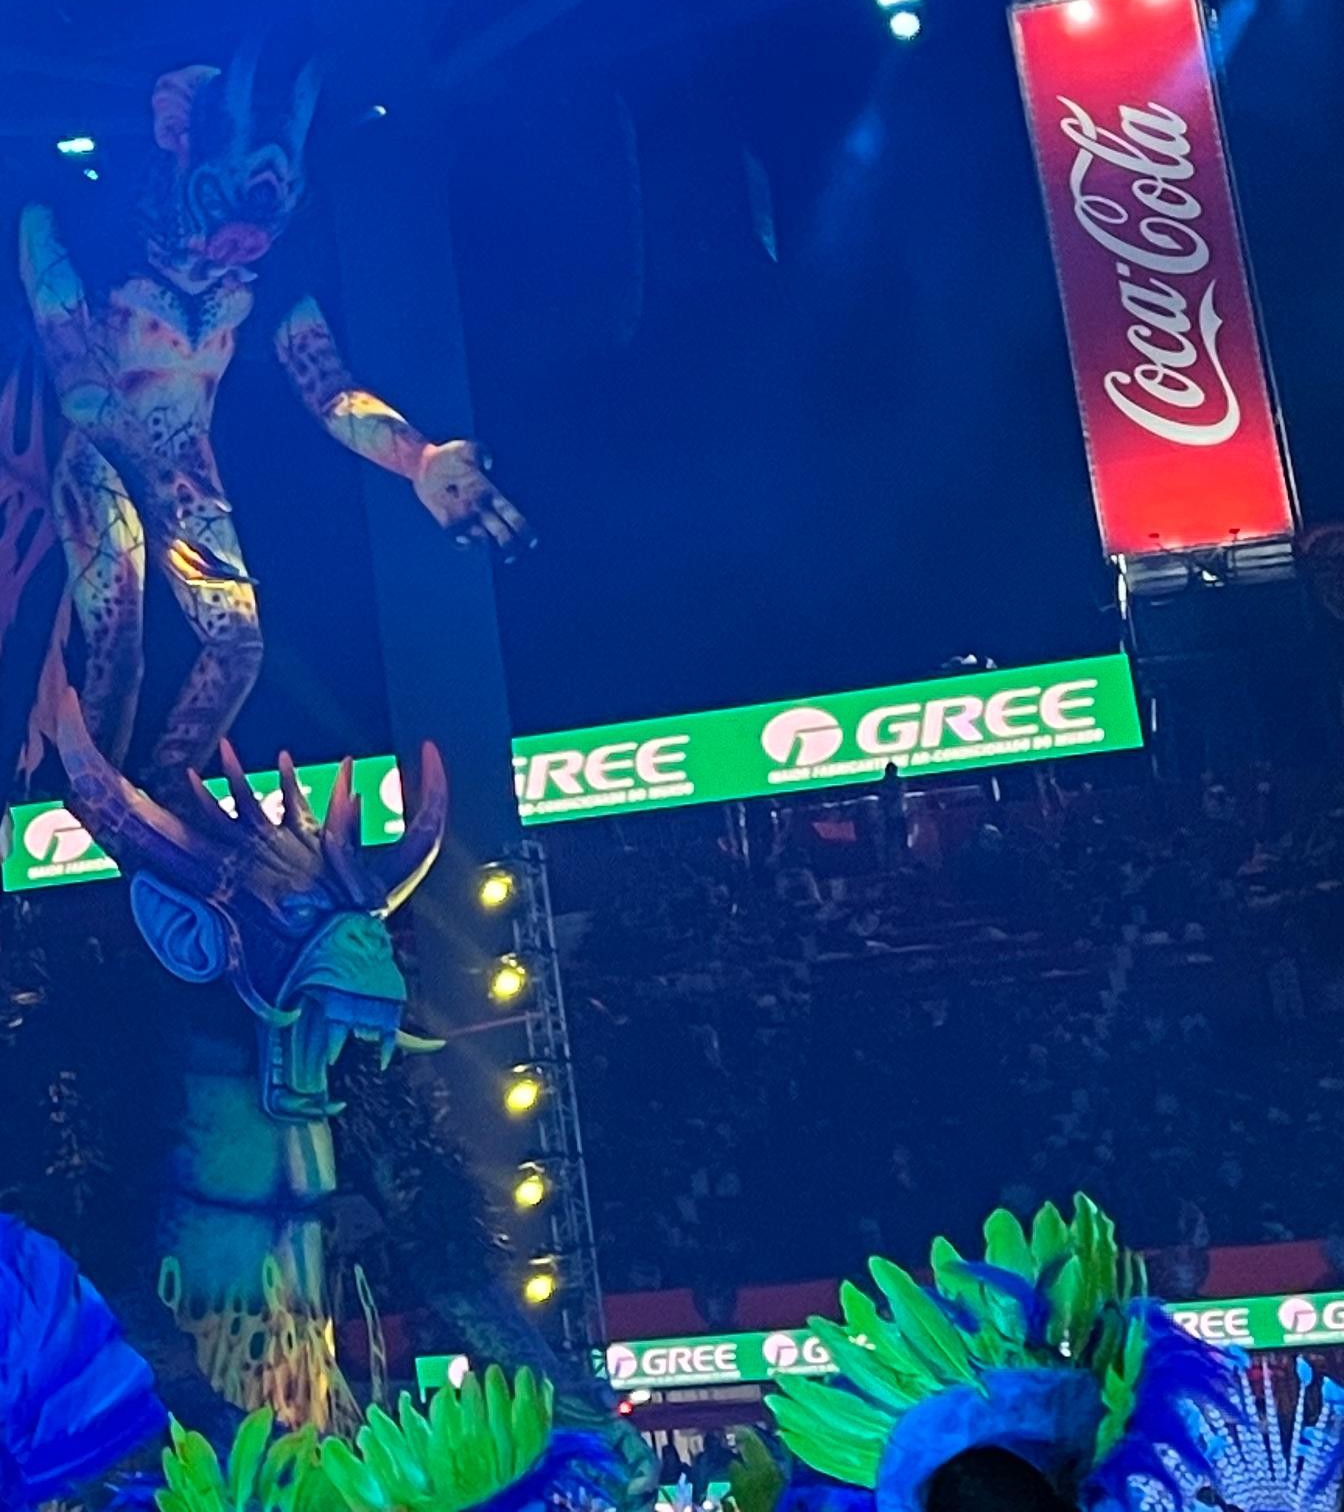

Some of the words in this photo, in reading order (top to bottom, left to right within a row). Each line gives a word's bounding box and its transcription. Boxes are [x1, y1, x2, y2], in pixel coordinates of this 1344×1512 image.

[1056, 95, 1241, 445] Coca-Cola
[855, 679, 1099, 755] GREE
[512, 735, 691, 800] REE
[1172, 1307, 1250, 1339] REE
[642, 1343, 738, 1376] GREE
